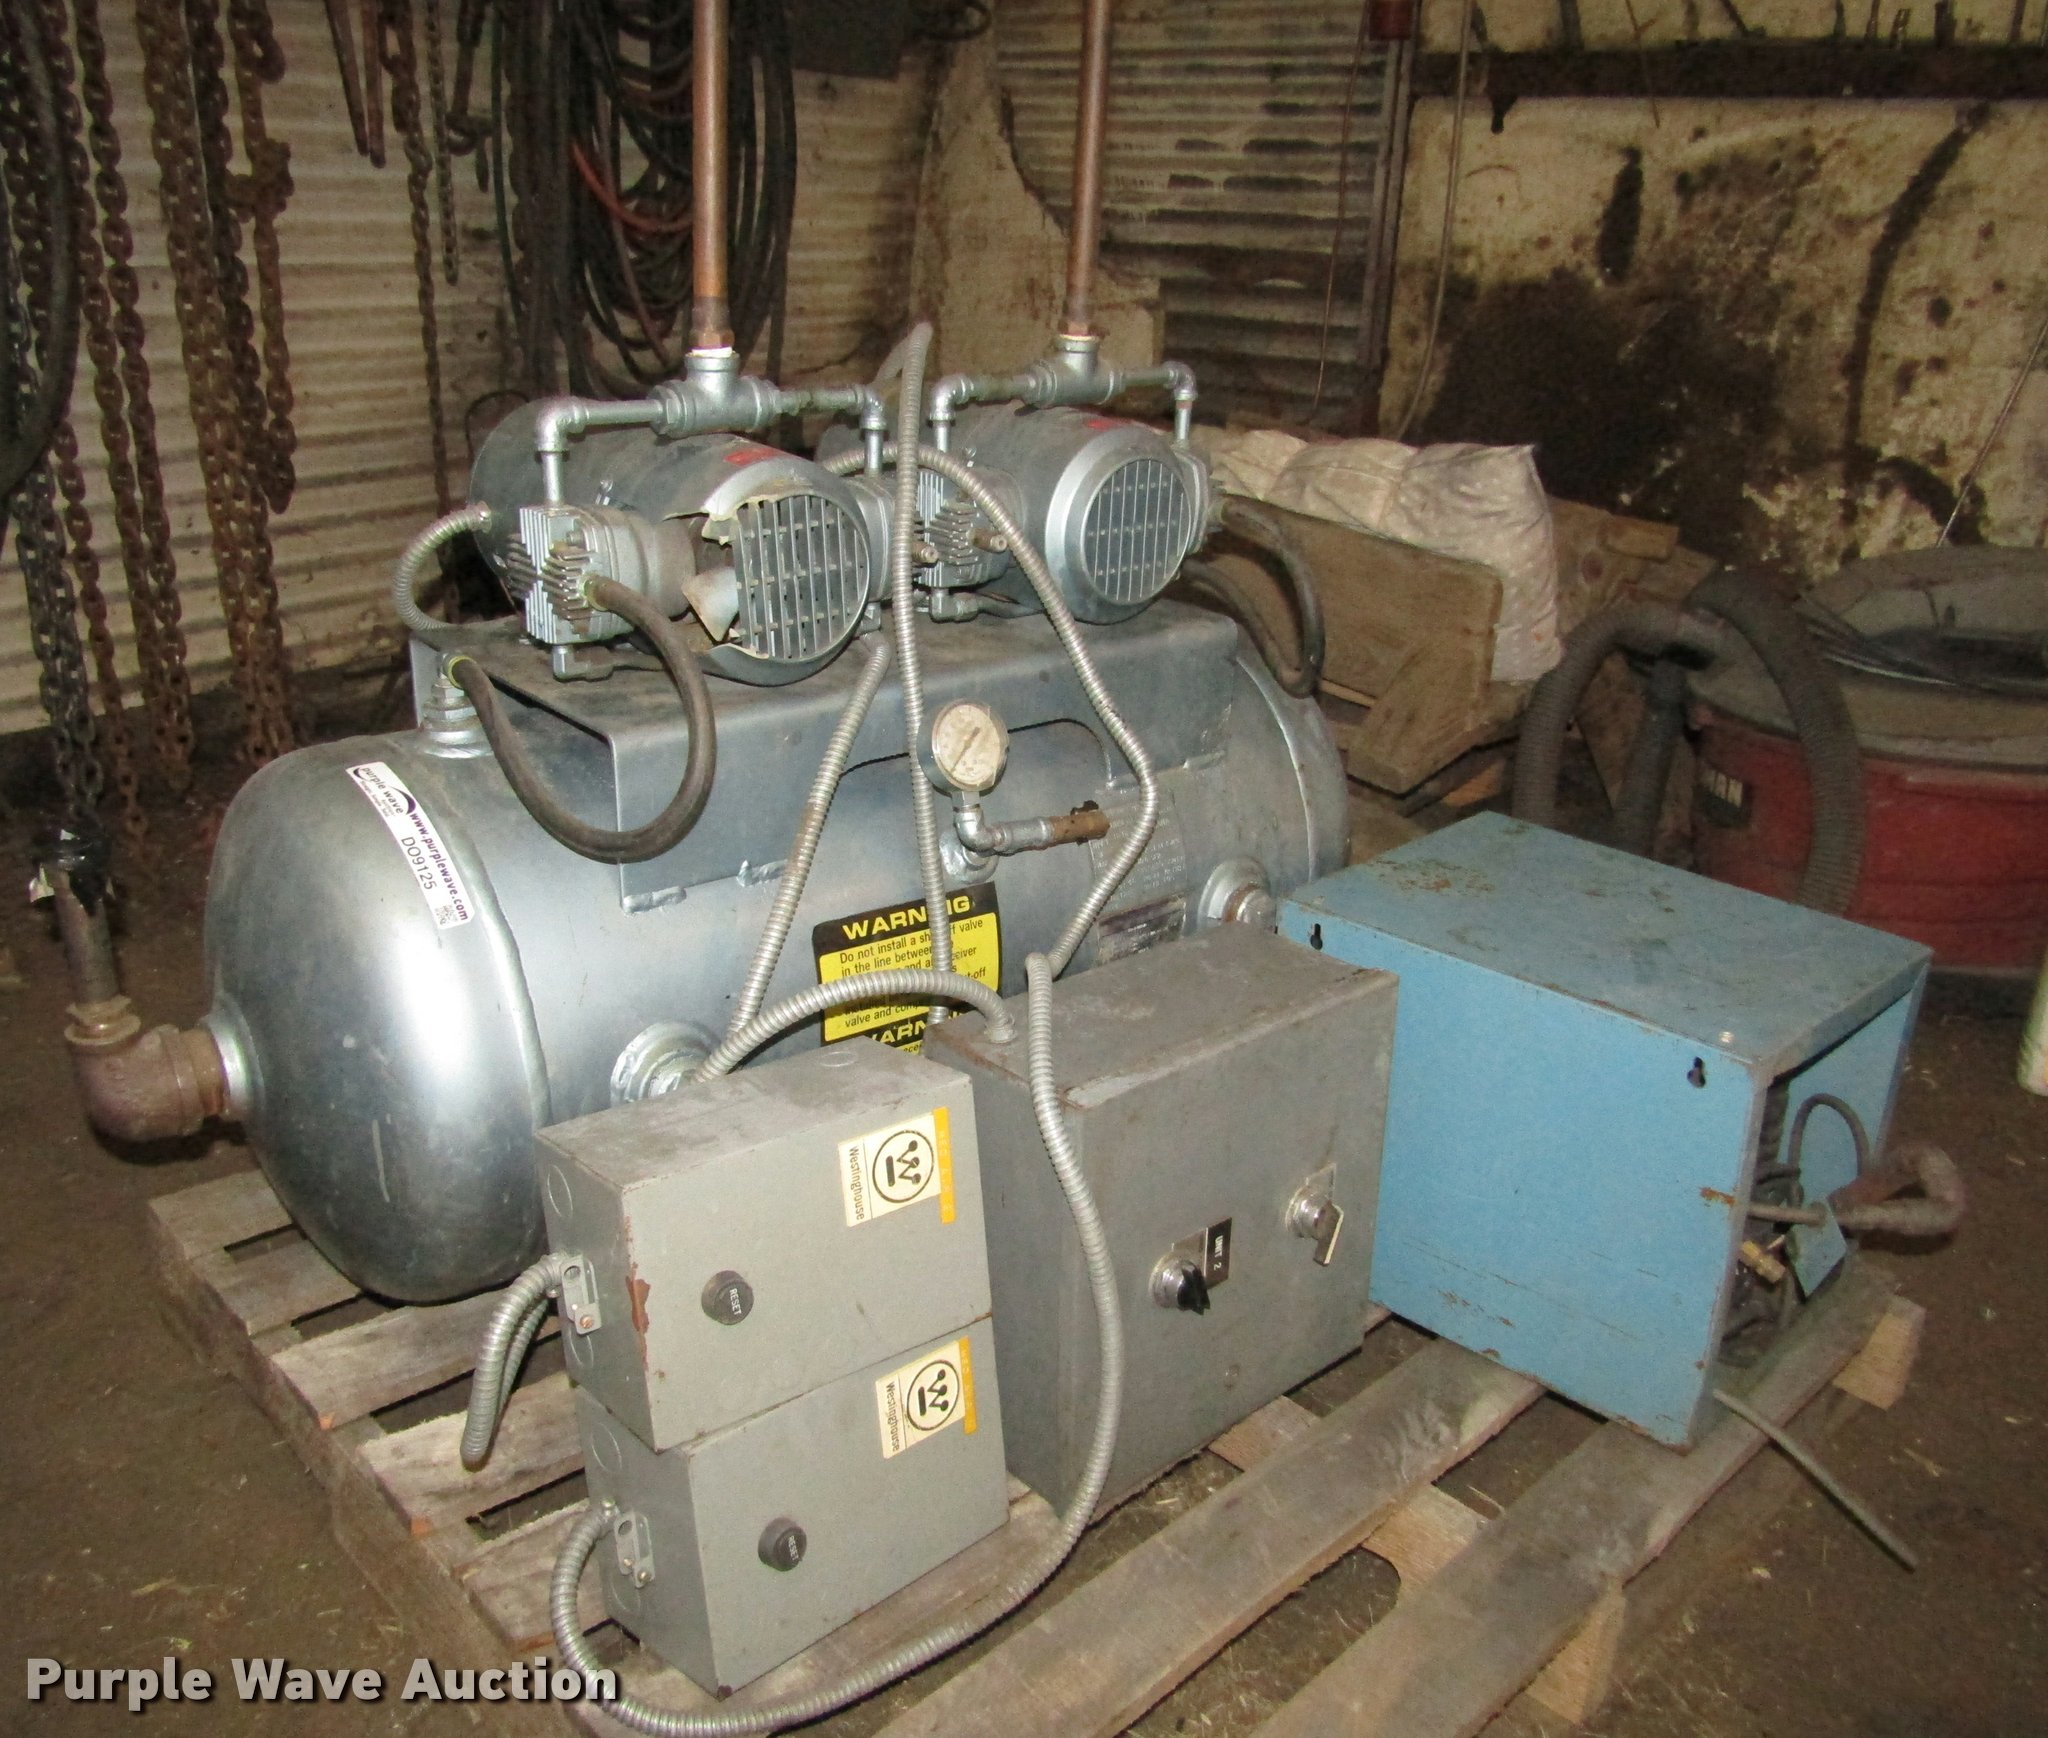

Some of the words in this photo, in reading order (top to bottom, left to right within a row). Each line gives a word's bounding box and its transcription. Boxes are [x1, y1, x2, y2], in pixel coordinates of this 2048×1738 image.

[360, 767, 386, 790] purple
[383, 790, 404, 814] wave
[409, 812, 469, 921] www.purplewave.com
[842, 895, 970, 940] WARNG
[840, 952, 854, 964] Do
[857, 946, 874, 960] not
[877, 937, 907, 954] install
[910, 937, 917, 946] a
[959, 919, 983, 933] valve
[854, 961, 871, 974] the
[874, 957, 892, 969] line
[845, 1014, 871, 1028] valve
[874, 1007, 892, 1020] and
[849, 1145, 865, 1221] Westinghouse
[729, 1288, 742, 1315] RESET
[886, 1380, 900, 1452] Westinghouse
